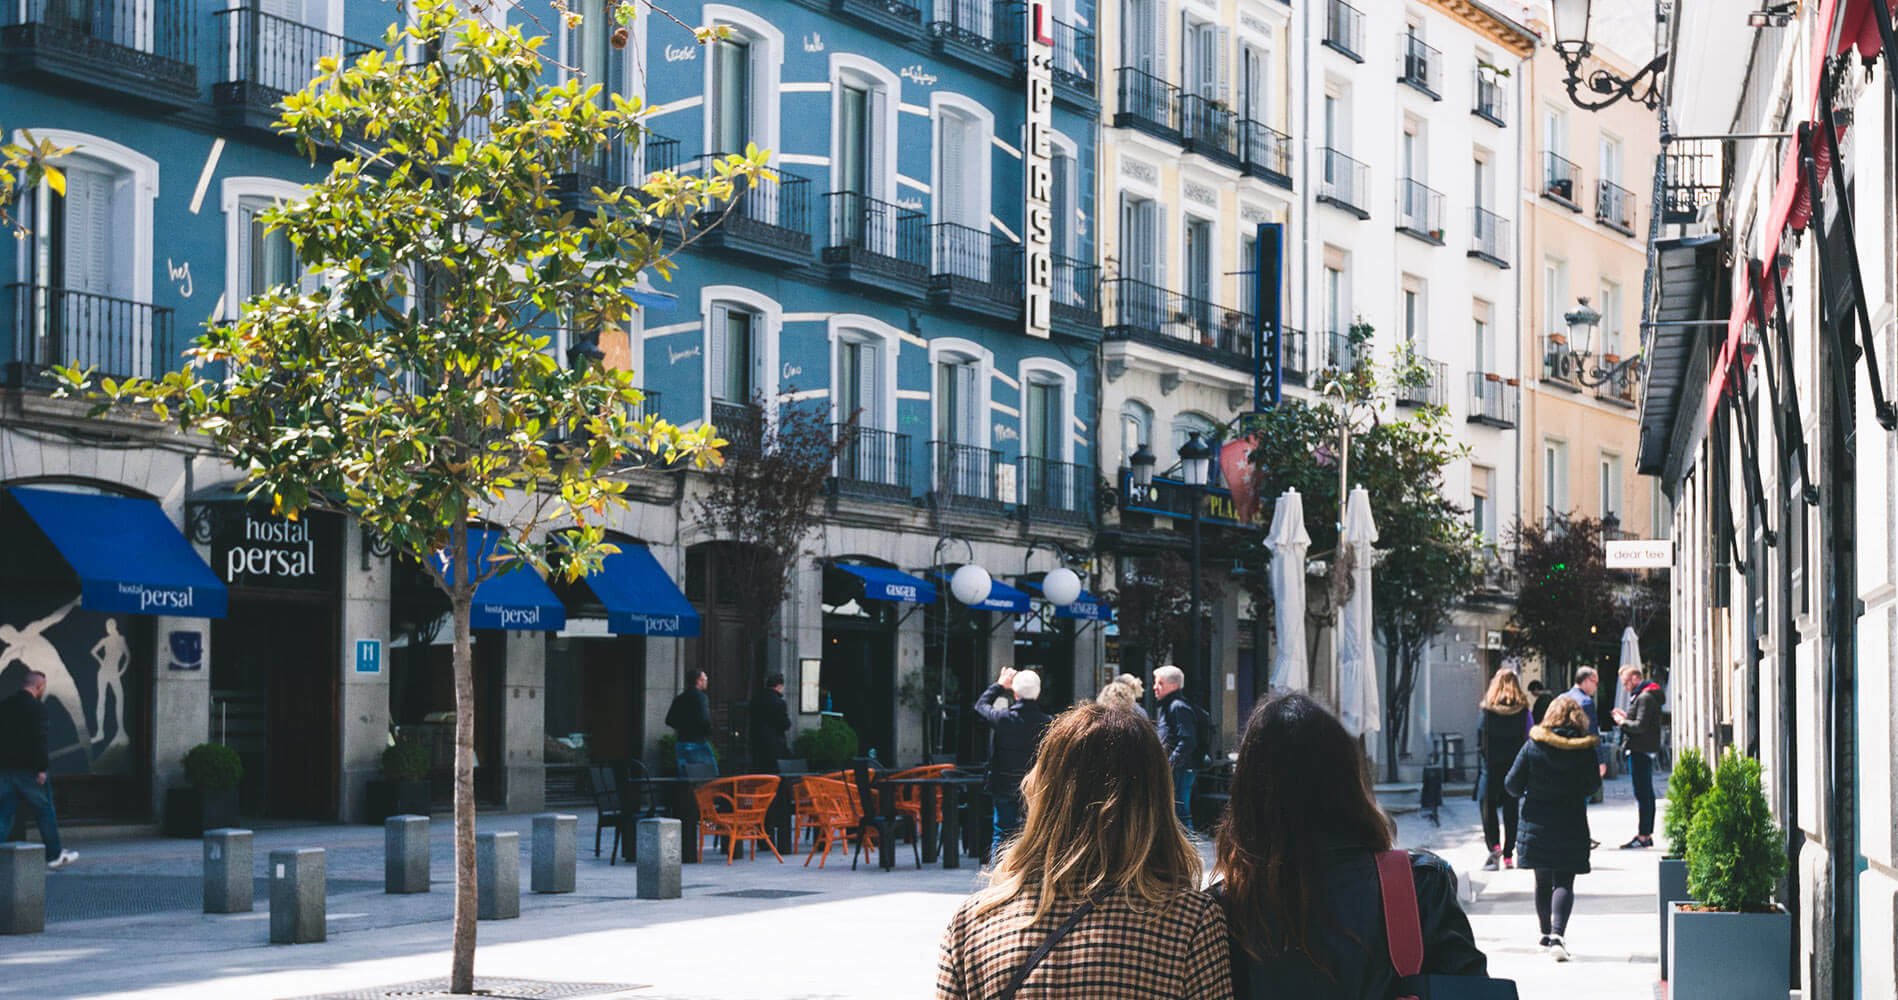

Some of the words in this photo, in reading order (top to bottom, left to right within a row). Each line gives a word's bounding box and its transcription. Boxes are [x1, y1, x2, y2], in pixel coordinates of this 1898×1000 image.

[168, 257, 192, 298] hey
[1262, 330, 1273, 402] PLAZA
[246, 517, 308, 543] hostal
[228, 540, 314, 583] persal
[118, 583, 143, 594] hostal
[141, 586, 193, 611] persal
[886, 584, 916, 598] GINGER
[501, 605, 540, 627] persal
[1069, 602, 1099, 616] GINGER
[645, 614, 679, 634] persal
